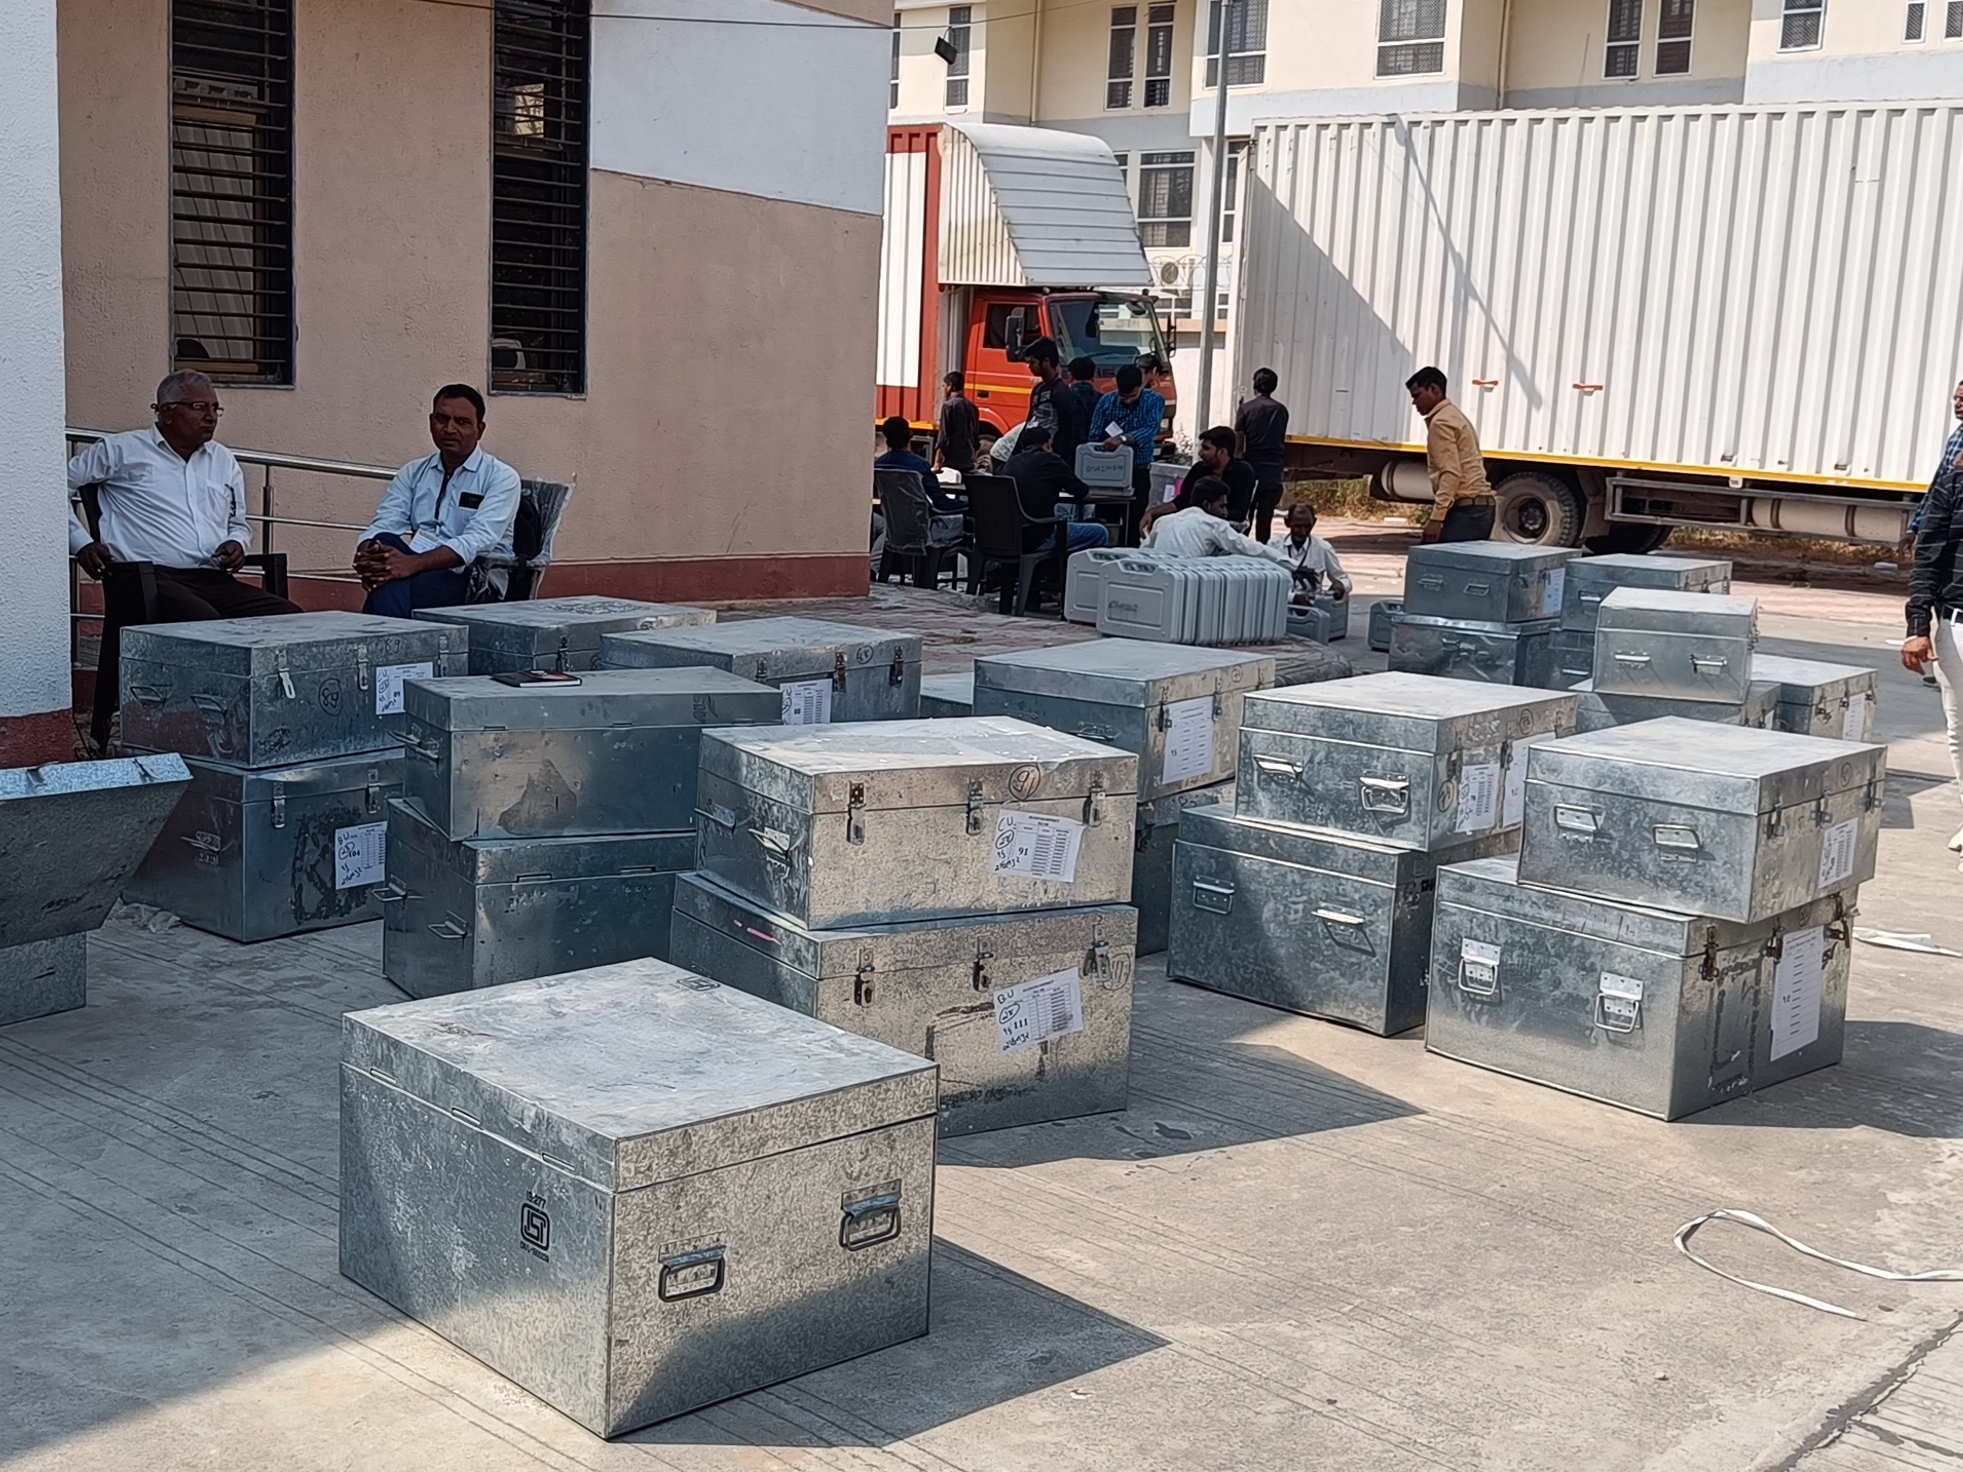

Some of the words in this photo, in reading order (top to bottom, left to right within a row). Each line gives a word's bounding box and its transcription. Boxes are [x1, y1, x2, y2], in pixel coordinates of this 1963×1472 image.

[1018, 846, 1029, 856] 91
[997, 989, 1015, 1004] BU
[1013, 1017, 1029, 1030] 111
